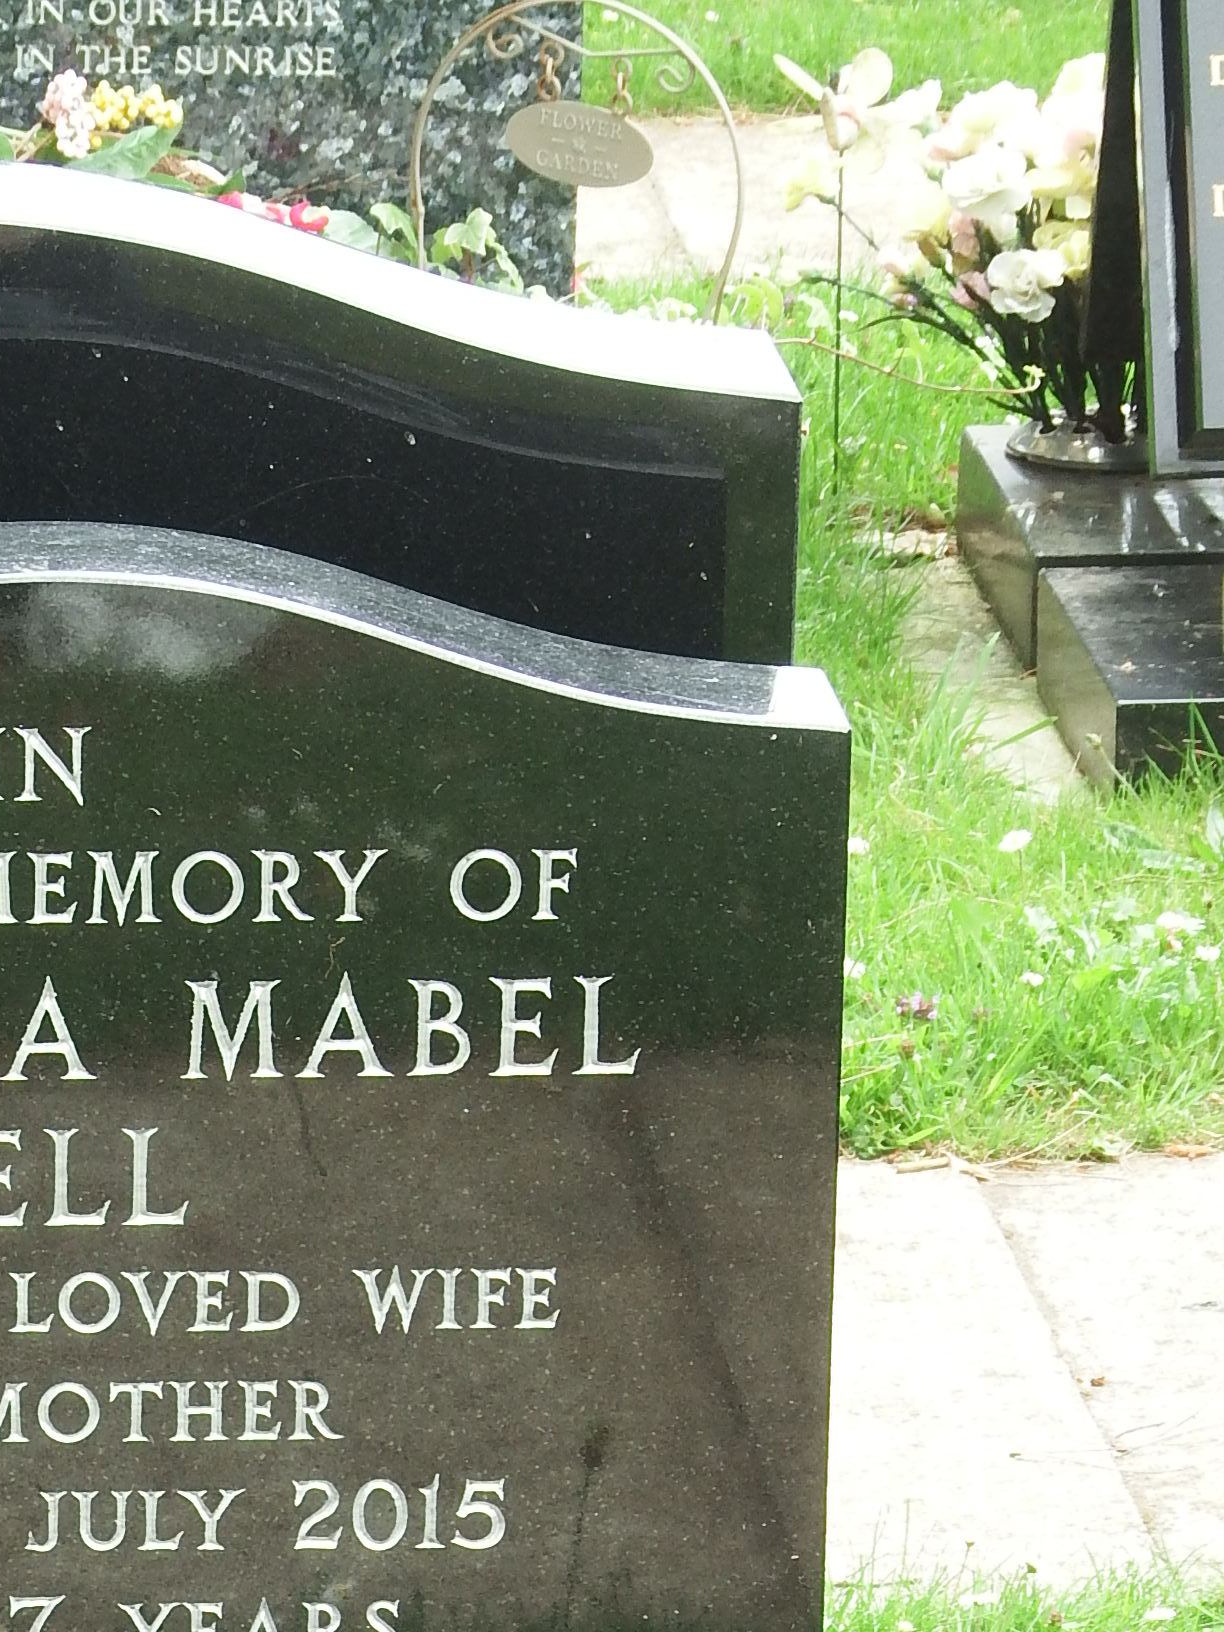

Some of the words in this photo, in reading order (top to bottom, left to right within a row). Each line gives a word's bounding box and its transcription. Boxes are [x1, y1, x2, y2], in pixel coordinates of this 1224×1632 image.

[26, 0, 64, 24] IN
[88, 0, 170, 25] OUR
[192, 0, 341, 27] HEARTS
[14, 44, 56, 73] IN
[75, 45, 152, 74] THE
[174, 45, 336, 76] SUNRISE
[539, 108, 623, 140] FLOWER
[535, 149, 620, 180] GARDEN
[449, 847, 578, 922] OF
[179, 971, 642, 1082] MABEL
[7, 1269, 301, 1337] LOVED
[351, 1264, 561, 1335] WIFE
[23, 1487, 247, 1553] JULY
[291, 1473, 507, 1552] 2015
